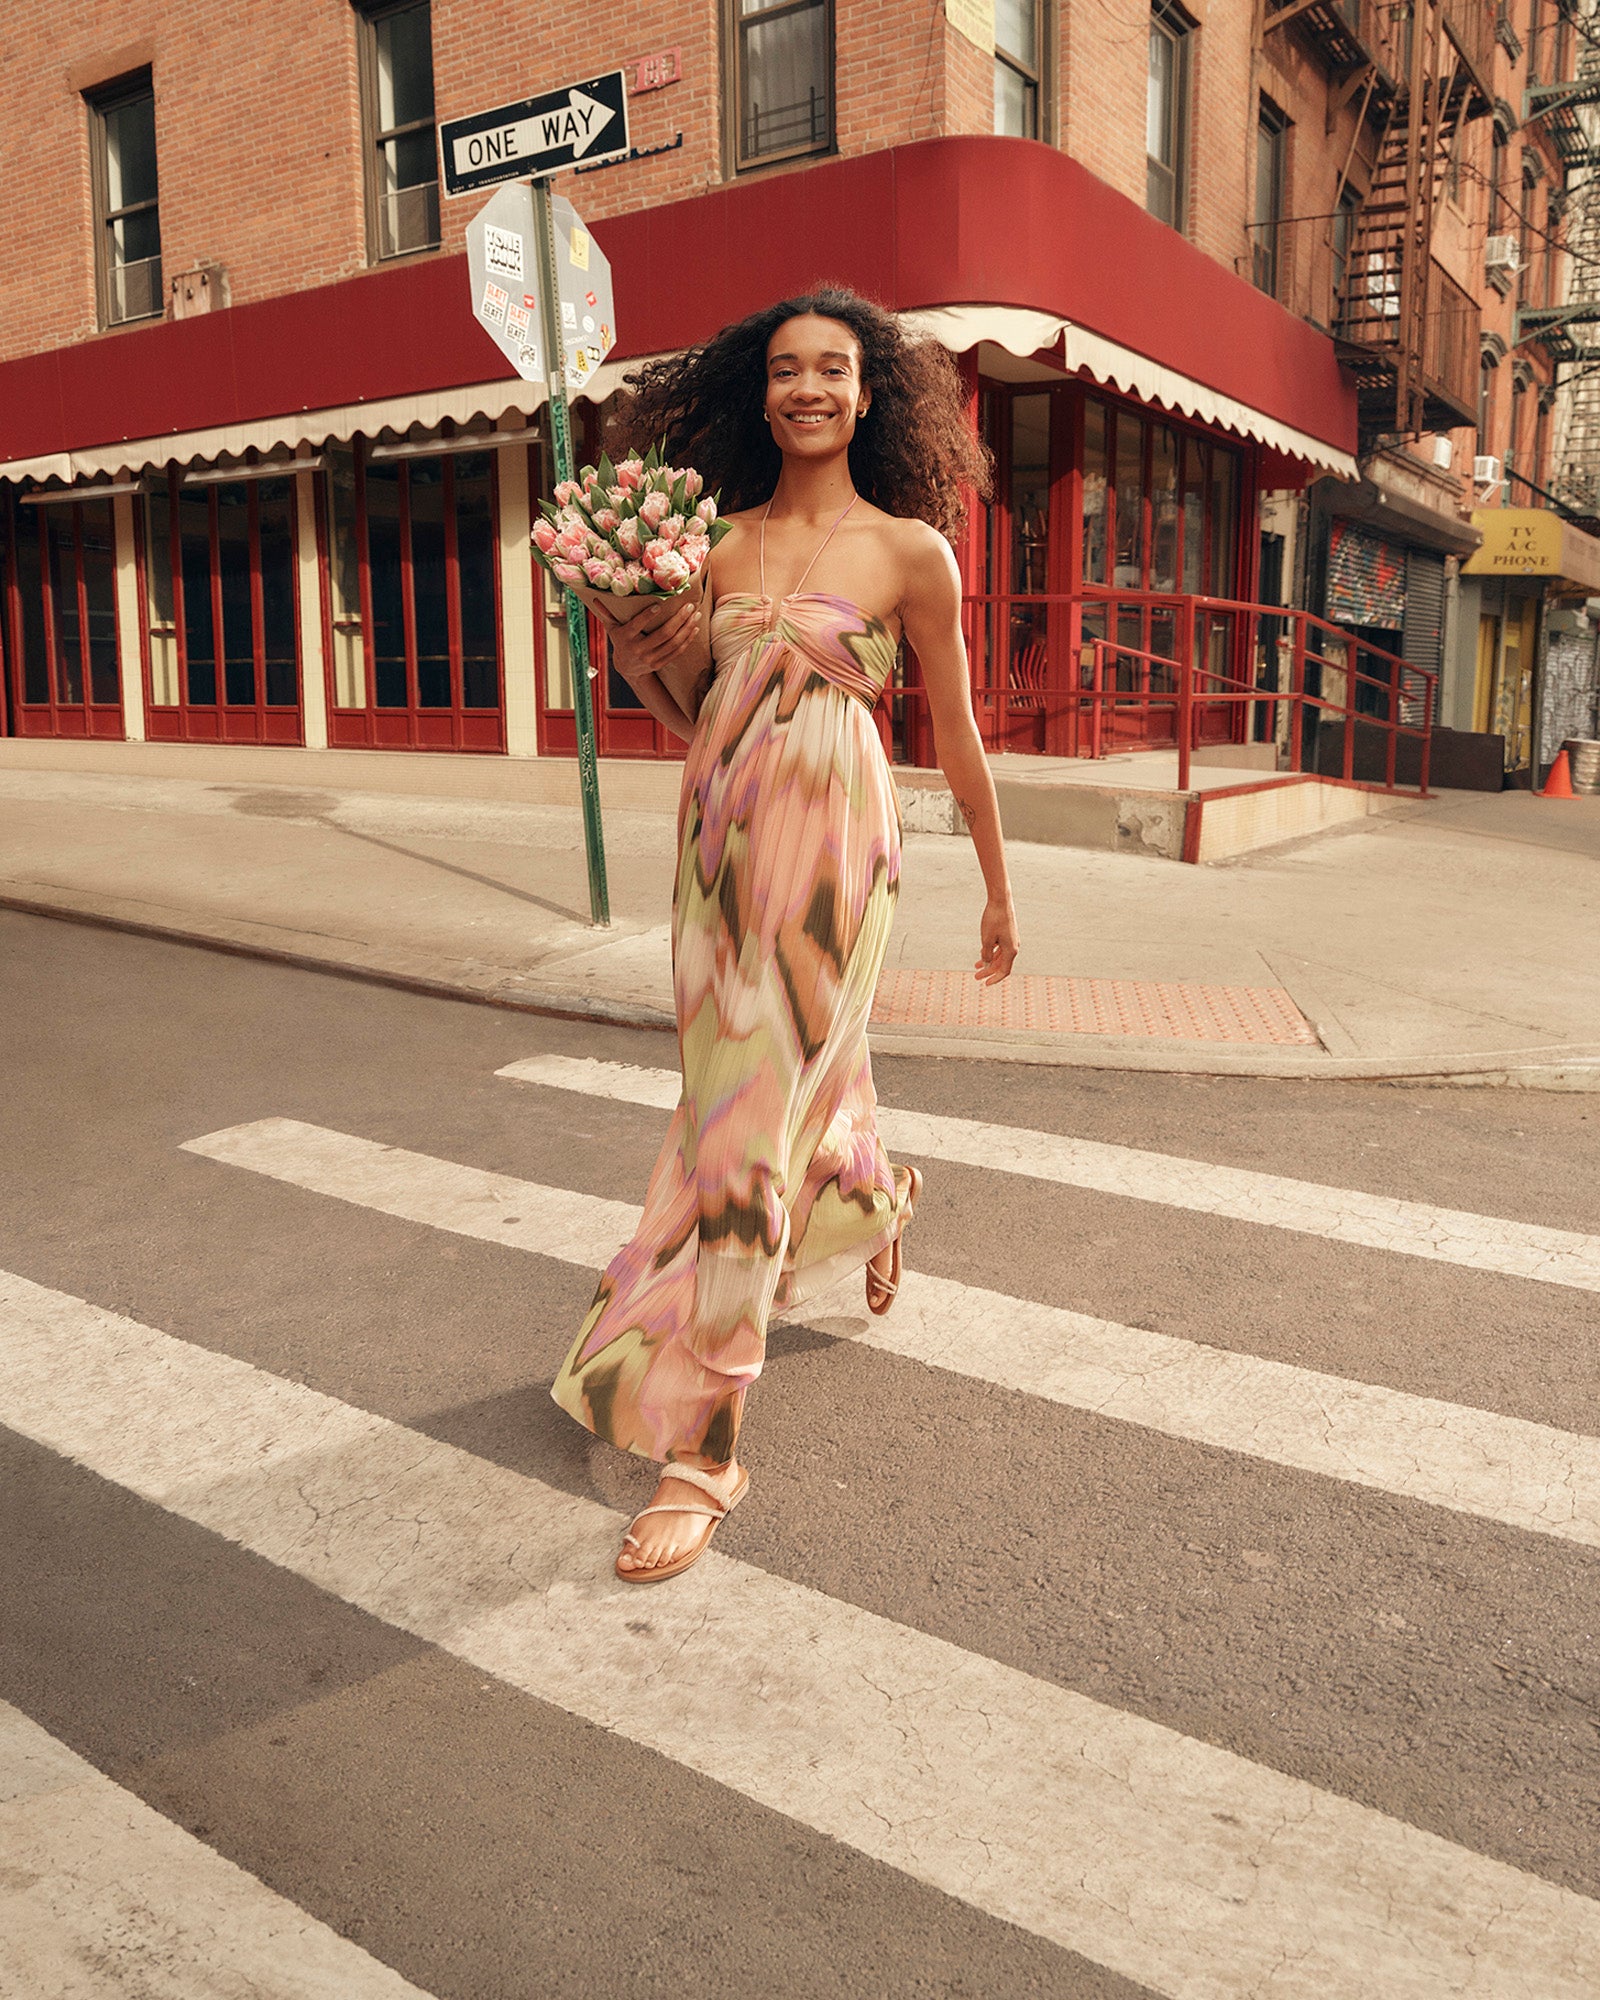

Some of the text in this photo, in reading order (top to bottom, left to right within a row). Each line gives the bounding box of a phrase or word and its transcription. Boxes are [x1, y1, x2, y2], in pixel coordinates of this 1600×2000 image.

[468, 128, 518, 166] ONE
[541, 105, 595, 146] WAY
[1510, 527, 1536, 537] TV
[1493, 555, 1549, 567] PHONE
